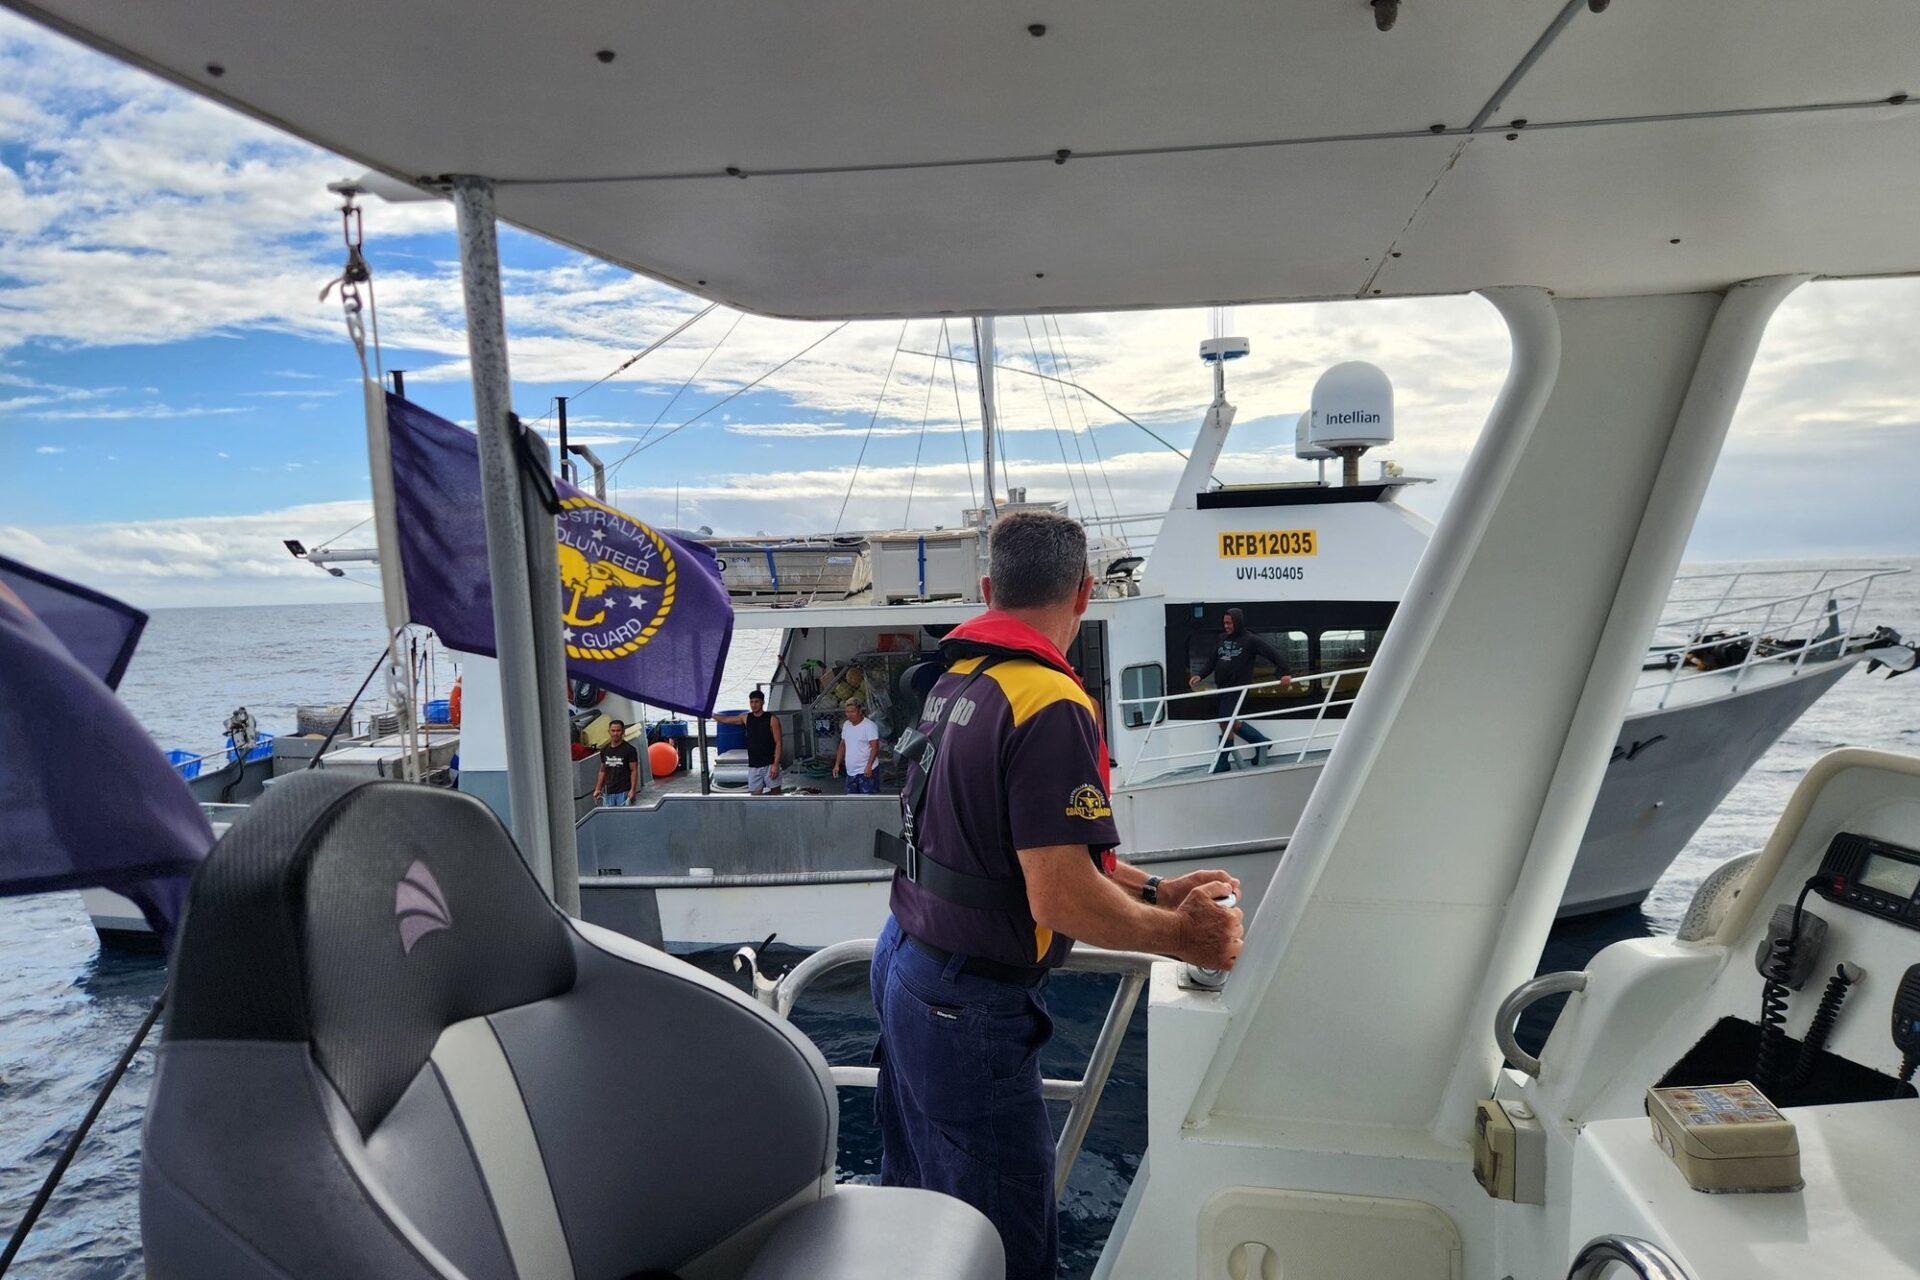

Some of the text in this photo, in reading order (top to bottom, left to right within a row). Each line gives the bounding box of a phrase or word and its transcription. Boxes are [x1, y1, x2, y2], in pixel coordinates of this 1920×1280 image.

[1326, 410, 1380, 425] Intellian
[557, 510, 658, 560] USTRALIAN
[1223, 532, 1312, 556] RFB12035
[556, 527, 650, 577] OLUNTEER
[1236, 566, 1304, 580] UVI-430405
[581, 618, 642, 648] GUARD
